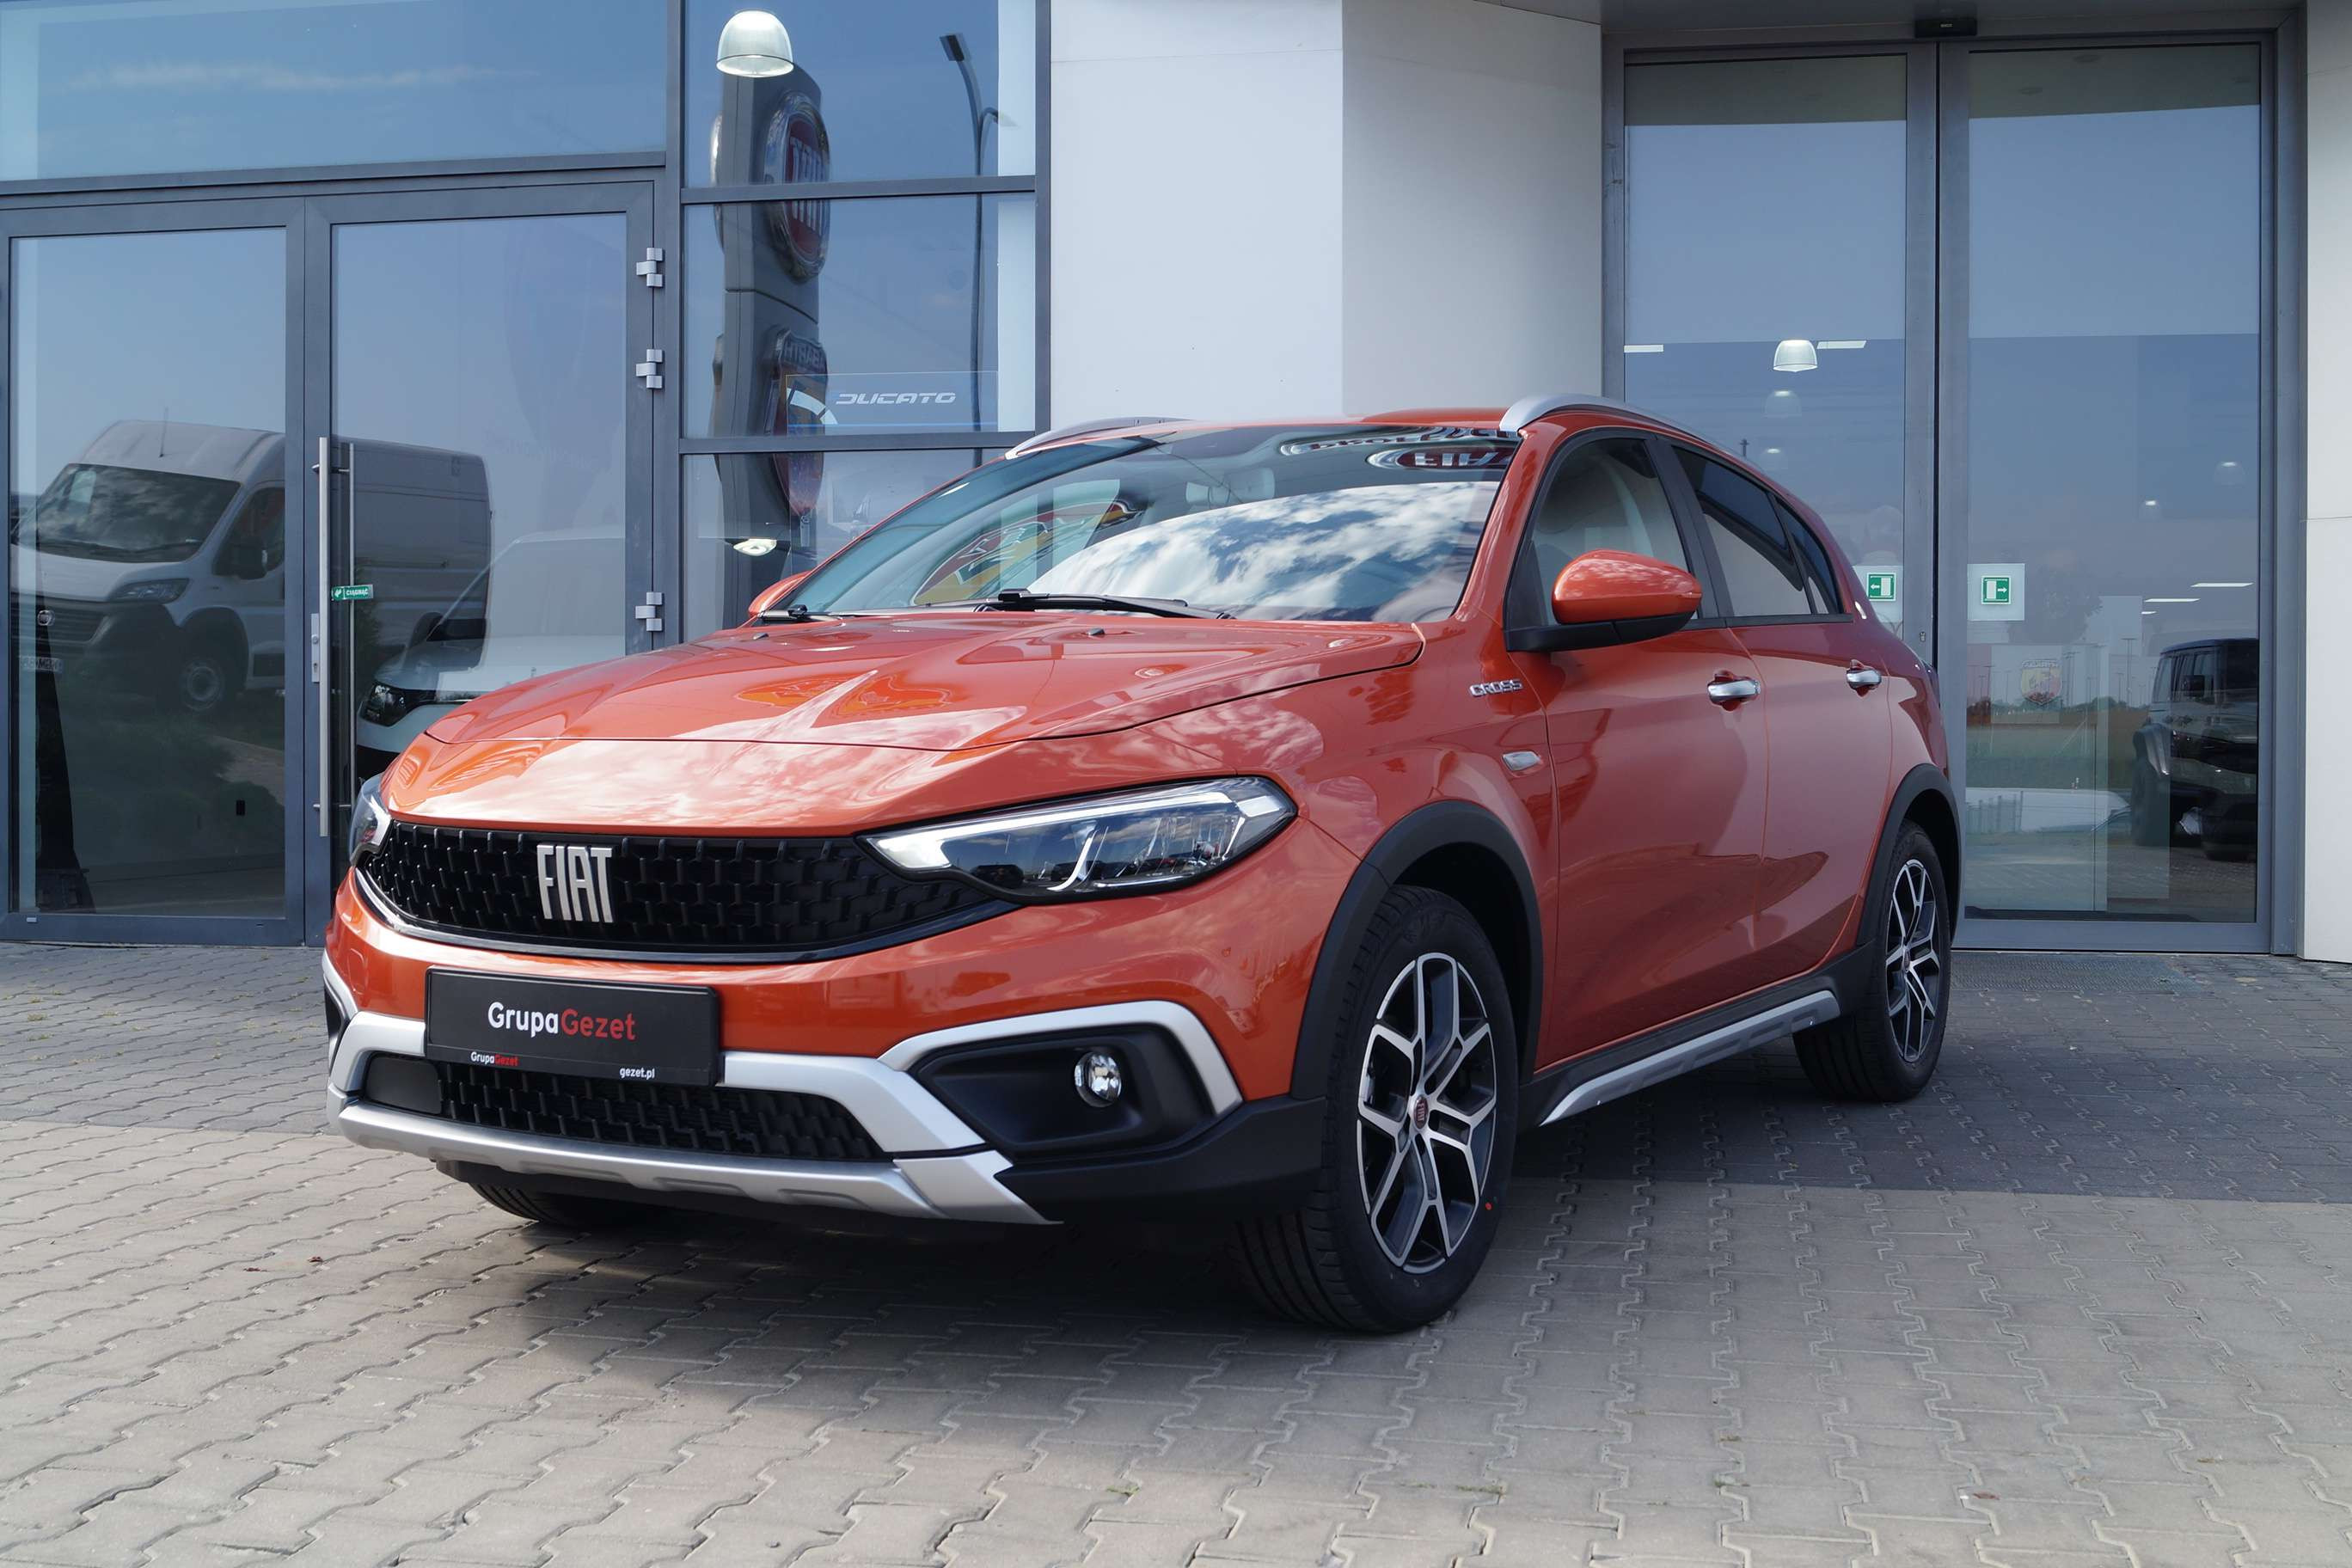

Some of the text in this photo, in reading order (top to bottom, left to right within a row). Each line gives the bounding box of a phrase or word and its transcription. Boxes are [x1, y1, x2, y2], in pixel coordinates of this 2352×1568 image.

[836, 392, 957, 406] DUCATO
[1469, 678, 1523, 696] CROSS
[536, 844, 613, 923] FIAT
[487, 1001, 636, 1041] GrupaGezet
[470, 1051, 520, 1067] GrupaGezet
[619, 1067, 656, 1080] gezet.pl
